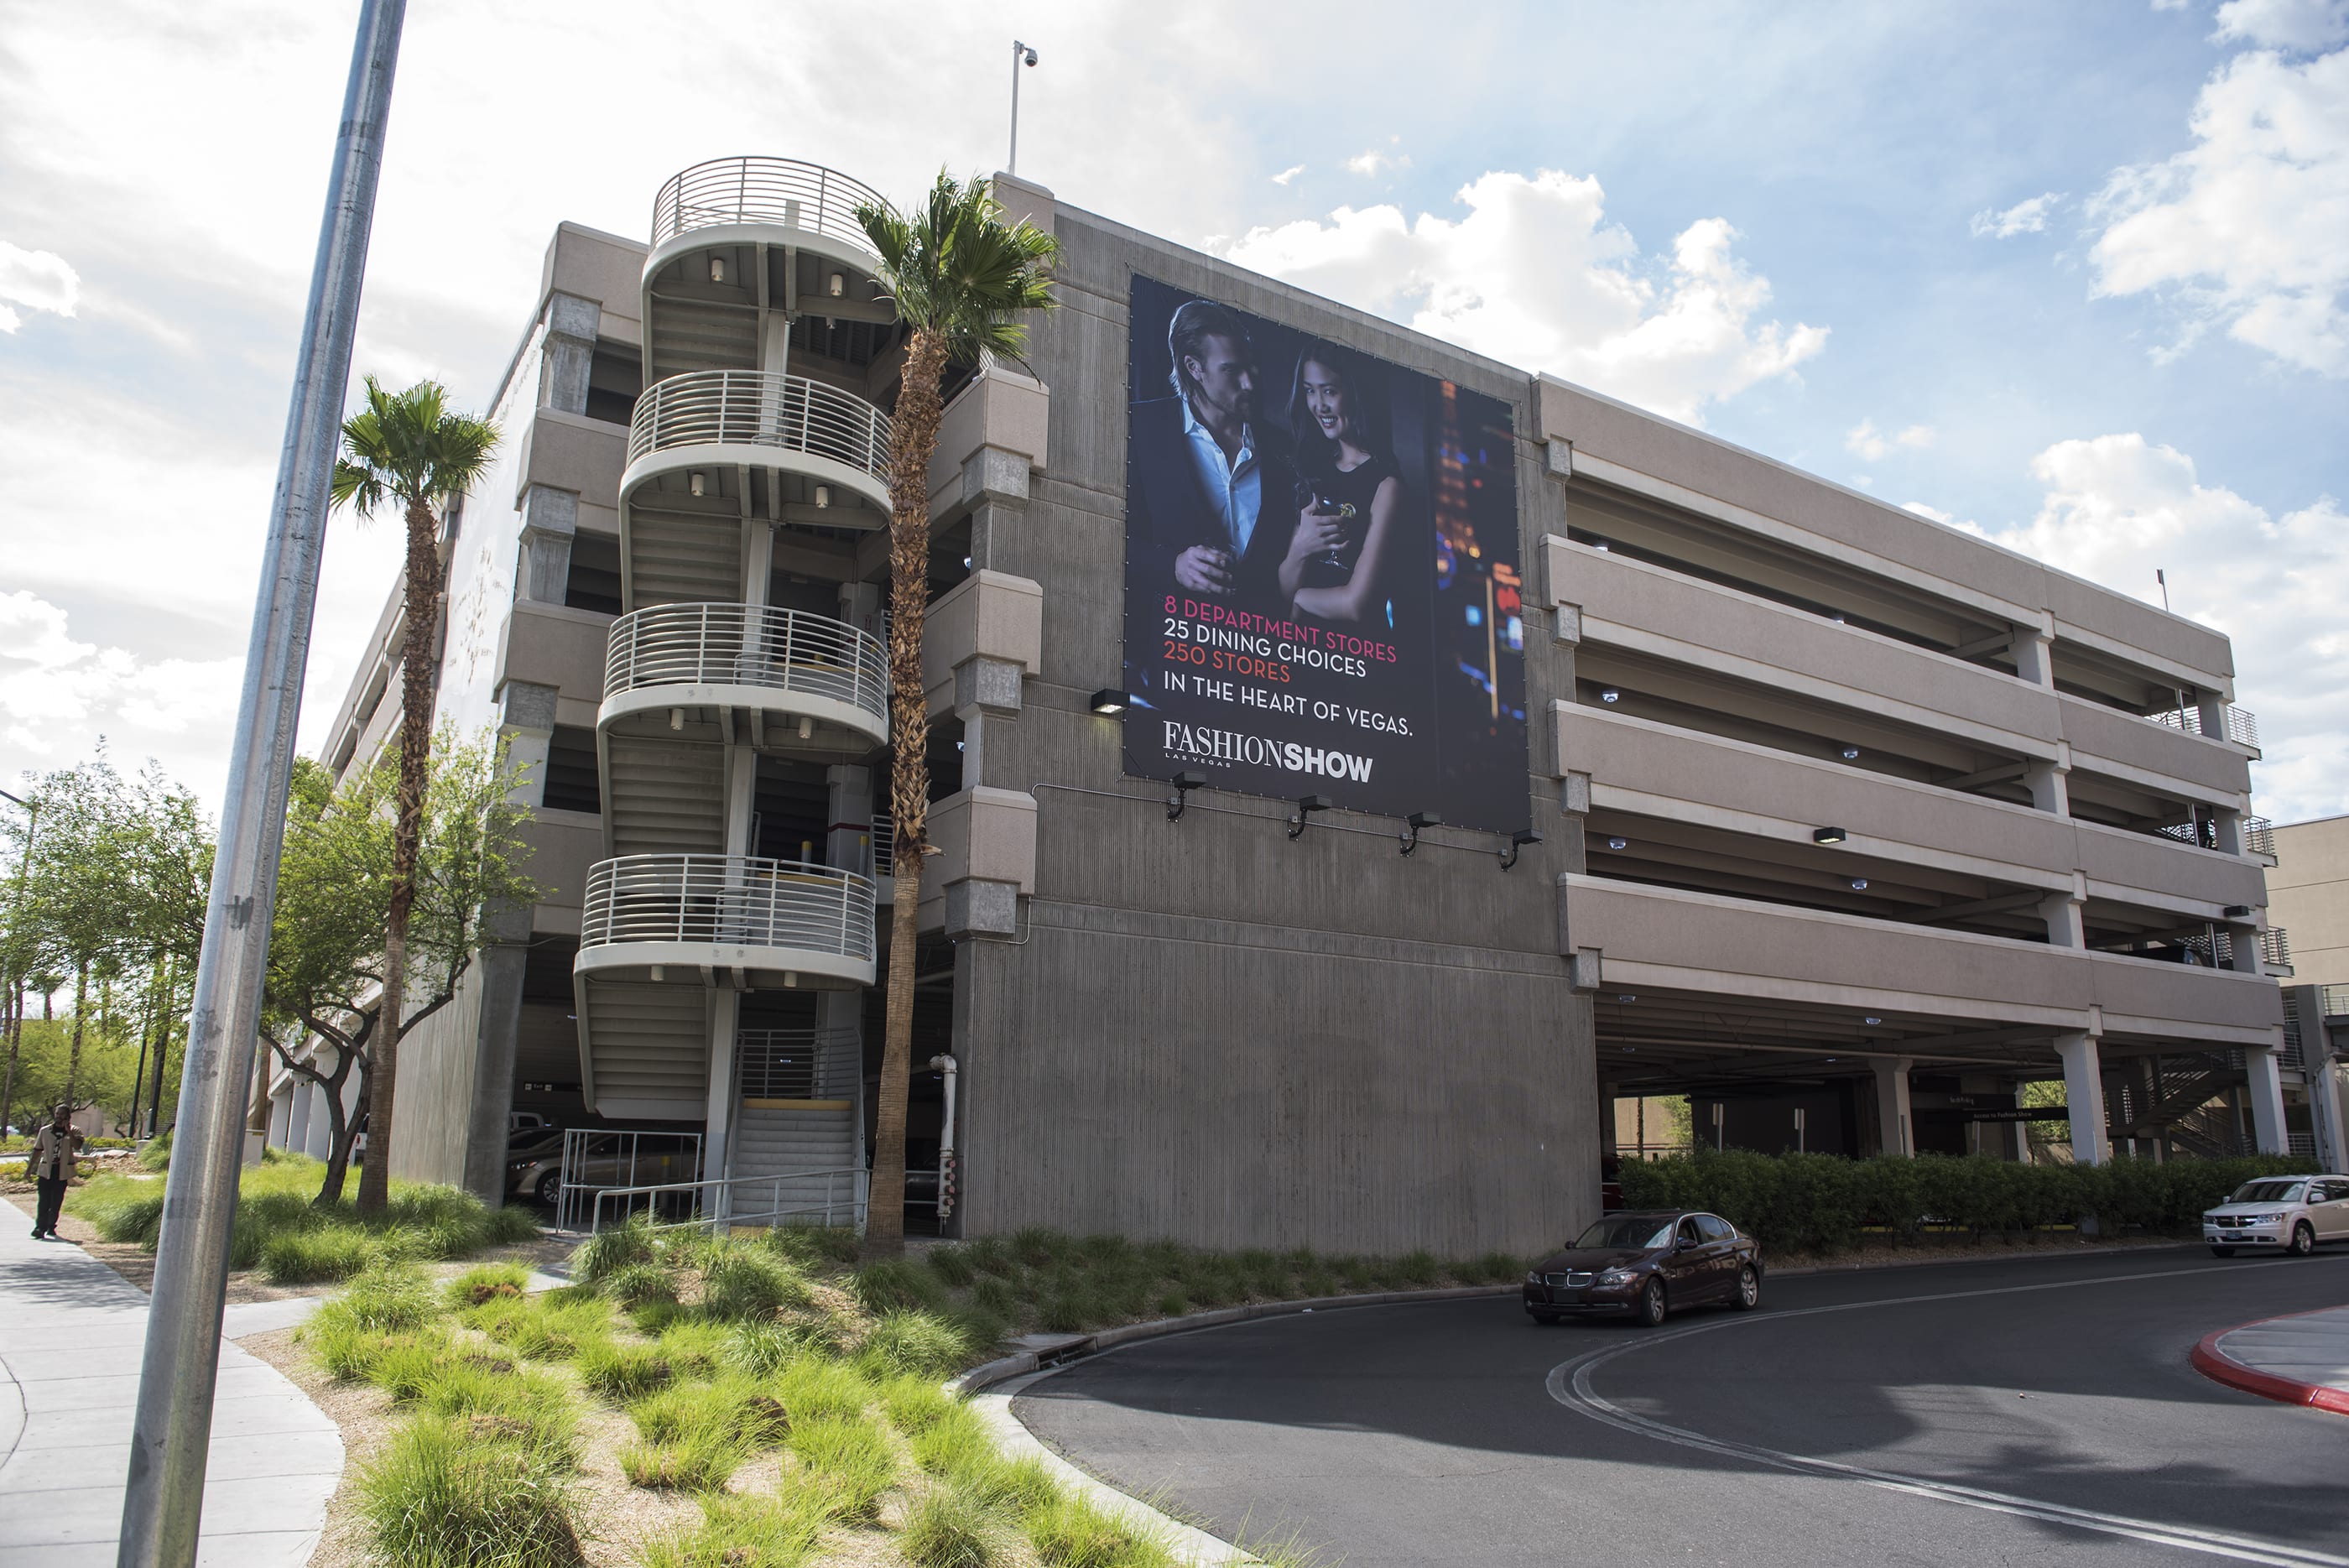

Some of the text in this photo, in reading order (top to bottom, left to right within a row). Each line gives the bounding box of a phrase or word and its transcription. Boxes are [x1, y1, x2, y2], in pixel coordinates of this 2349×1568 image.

[1163, 617, 1367, 678] 25 DINING CHOICES
[1164, 595, 1397, 663] 8 DEPARTMENT STORES
[1164, 640, 1290, 683] 250 STORES
[1164, 670, 1414, 737] IN THE HEART OF VEGAS.
[1164, 752, 1231, 768] LAS VEGAS
